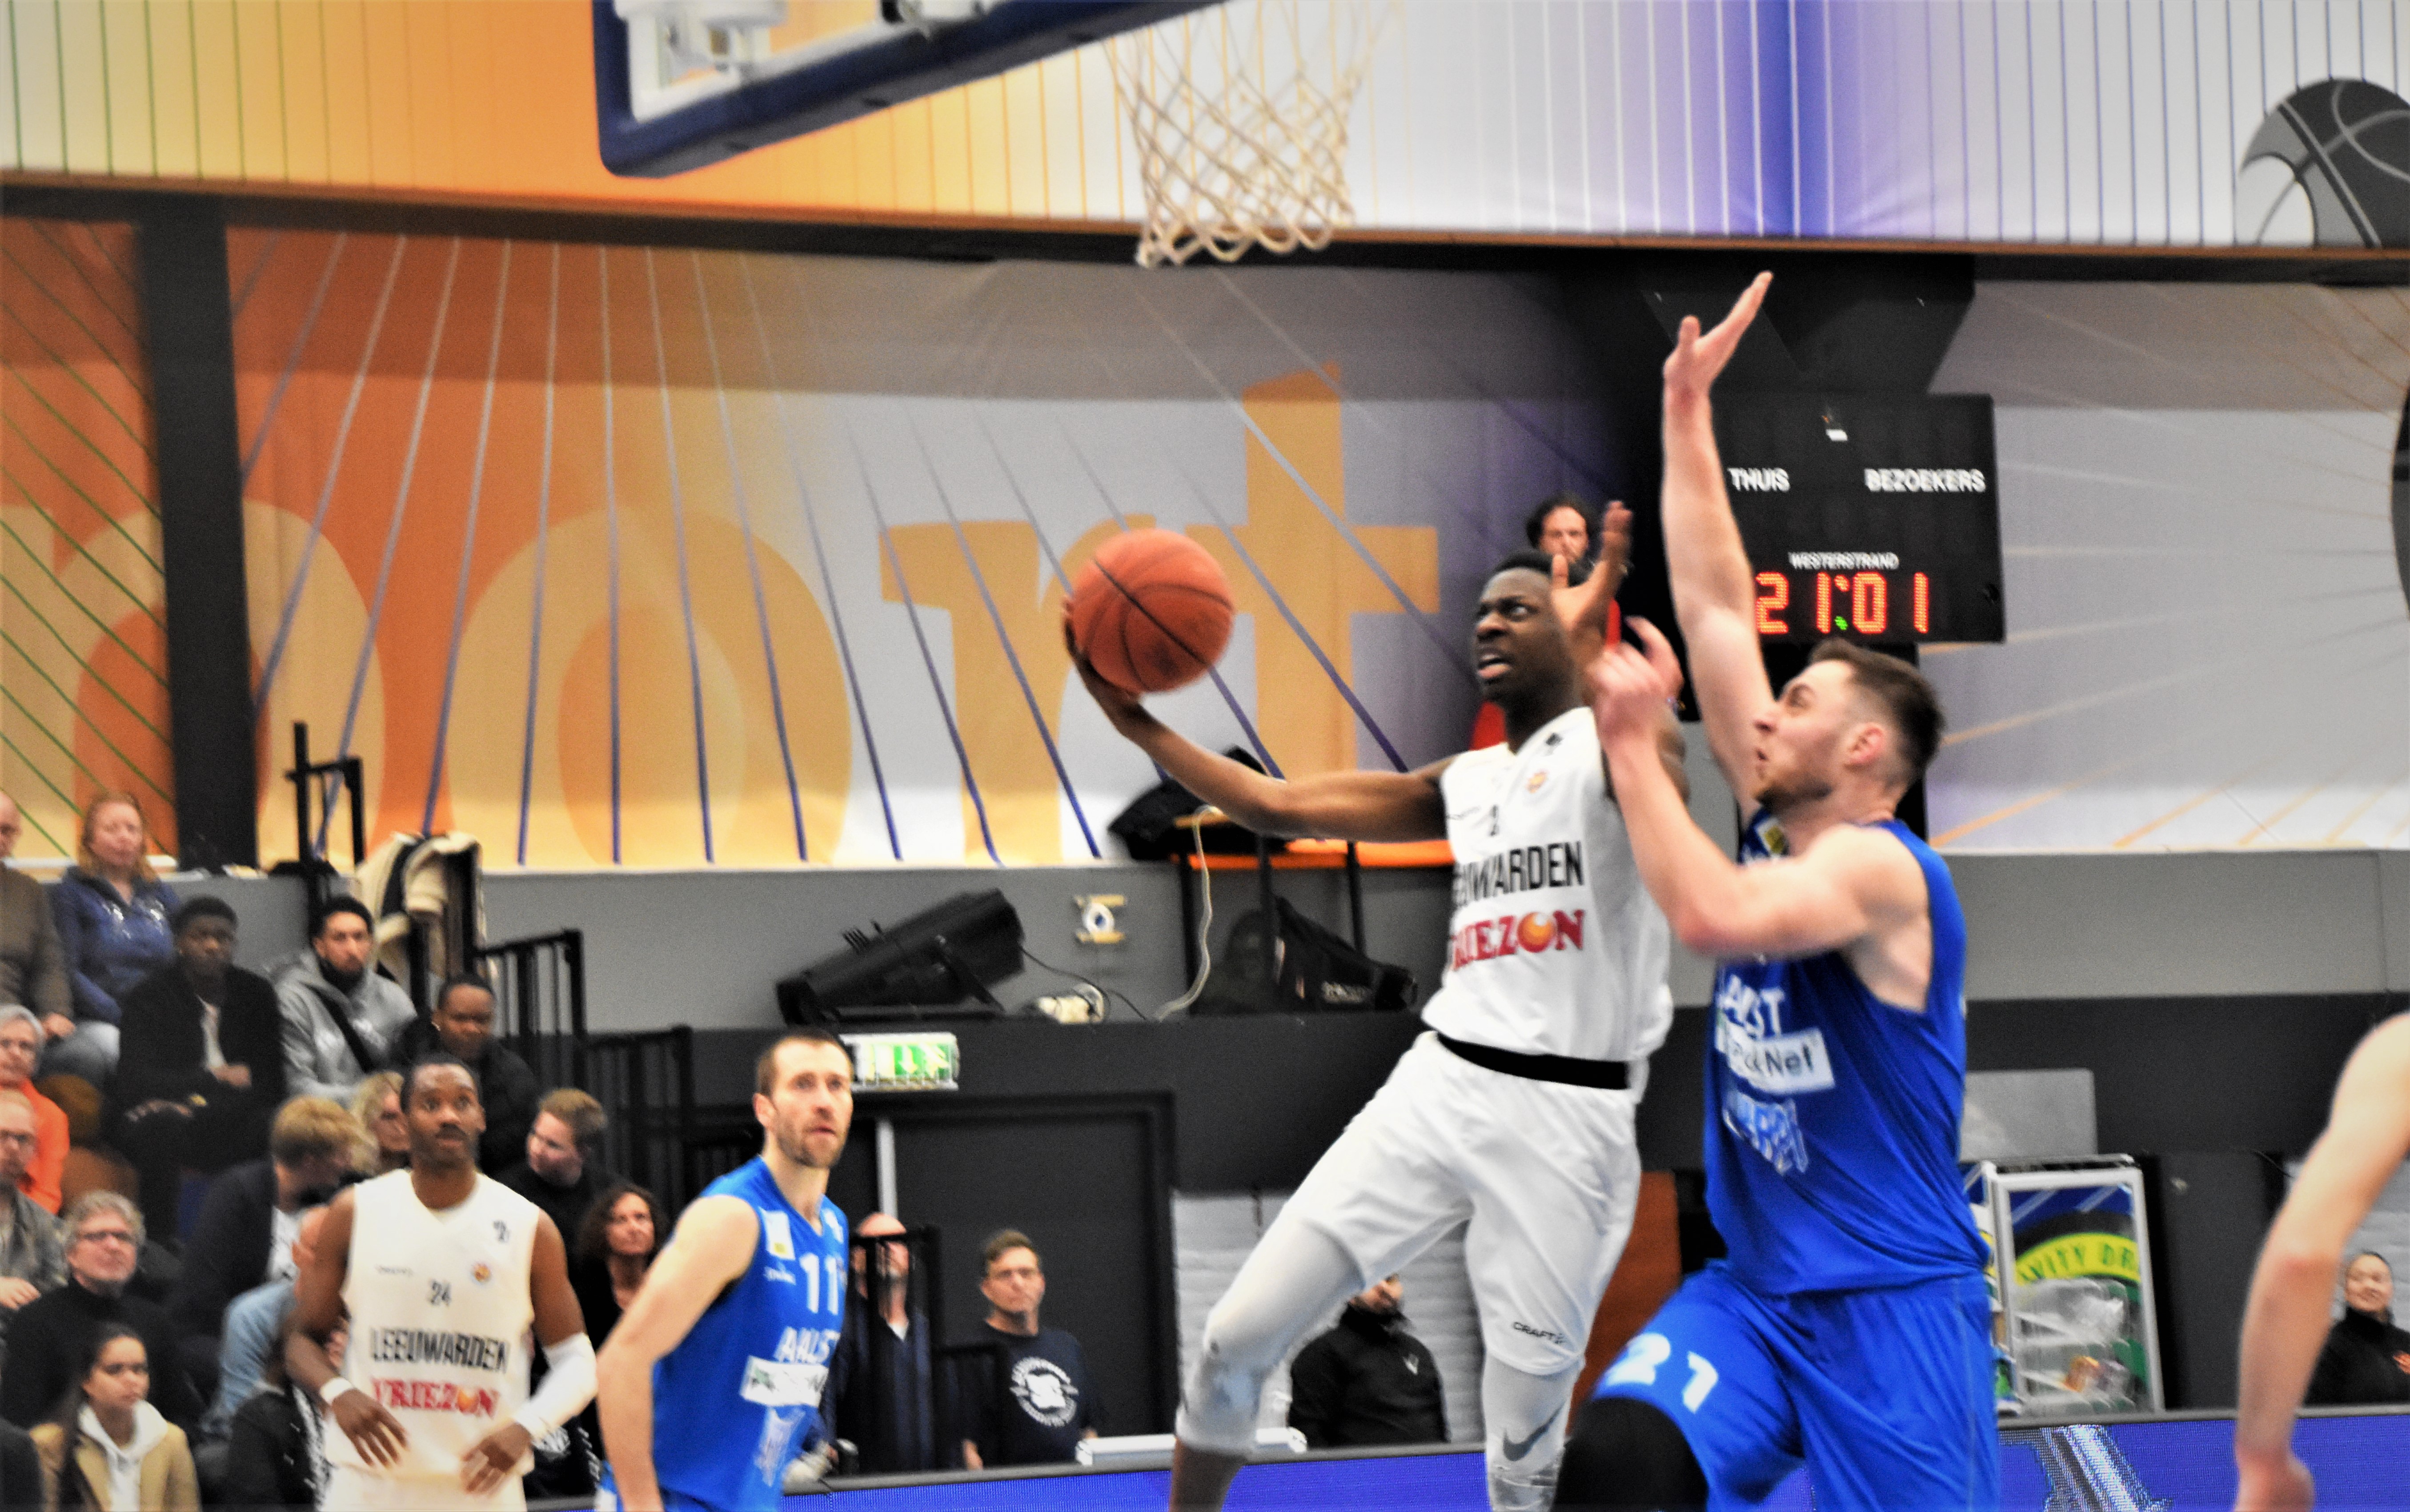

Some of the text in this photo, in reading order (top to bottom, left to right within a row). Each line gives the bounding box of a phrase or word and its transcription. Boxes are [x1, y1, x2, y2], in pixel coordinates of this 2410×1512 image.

[1727, 467, 1790, 493] THUIS
[1864, 468, 1986, 493] BEZOEKERS
[1788, 552, 1899, 570] WESTERSTRAND
[429, 1279, 452, 1306] 24
[799, 1252, 839, 1315] 11
[370, 1327, 511, 1374] LEEUWARDEN
[1604, 1332, 1719, 1414] 21
